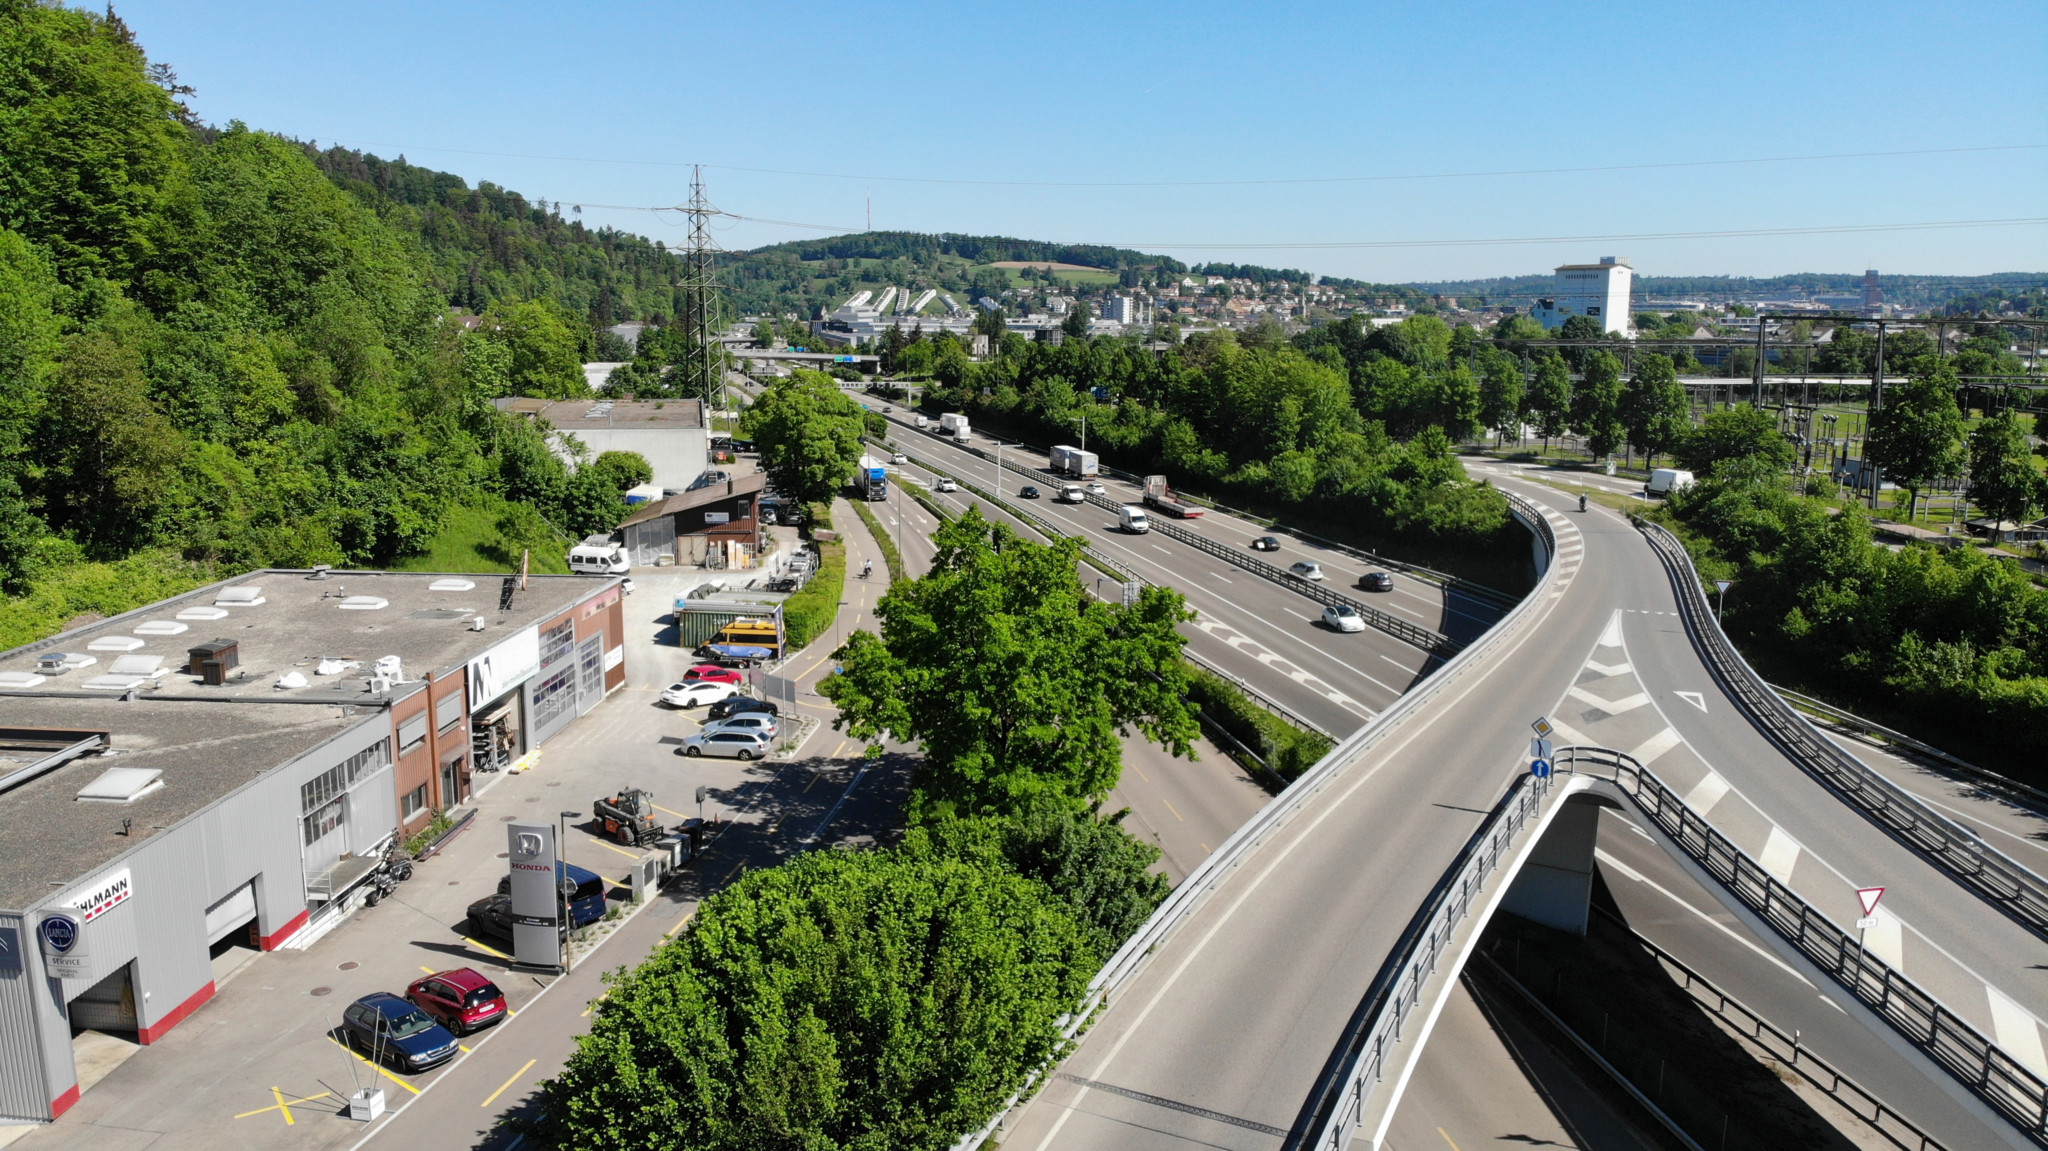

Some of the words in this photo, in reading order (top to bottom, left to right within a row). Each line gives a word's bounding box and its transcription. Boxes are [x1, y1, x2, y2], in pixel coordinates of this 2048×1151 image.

[512, 862, 551, 872] HONDA
[75, 877, 128, 912] HLMANN
[48, 928, 71, 938] LANCIA
[52, 958, 81, 966] SERVICE
